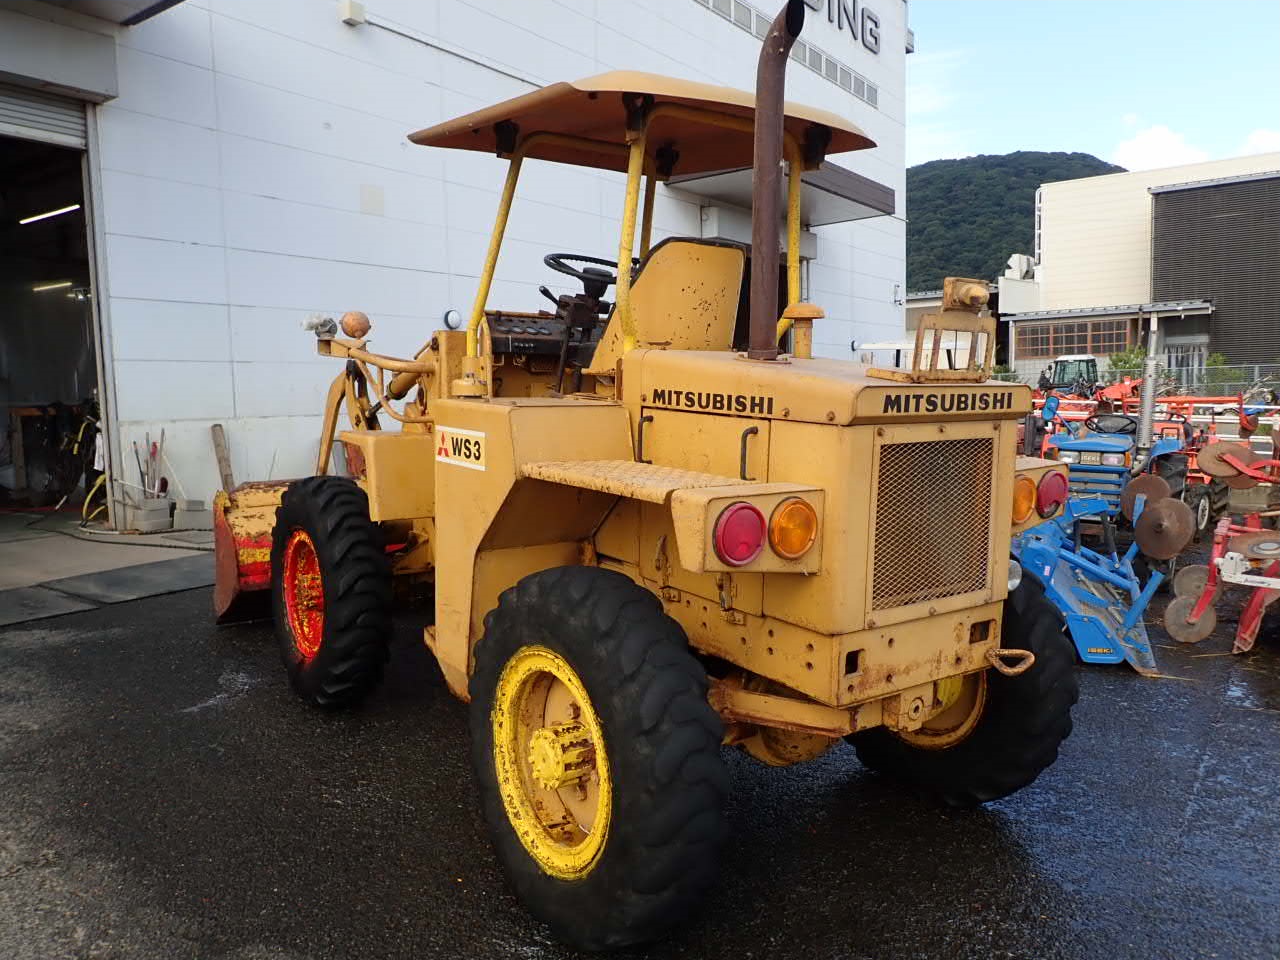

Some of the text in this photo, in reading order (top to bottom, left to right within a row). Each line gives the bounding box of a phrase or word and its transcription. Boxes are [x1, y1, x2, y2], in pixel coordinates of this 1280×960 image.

[652, 388, 774, 415] MITSUBISHI
[882, 391, 1013, 414] MITSUBISHI
[451, 436, 481, 461] WS3
